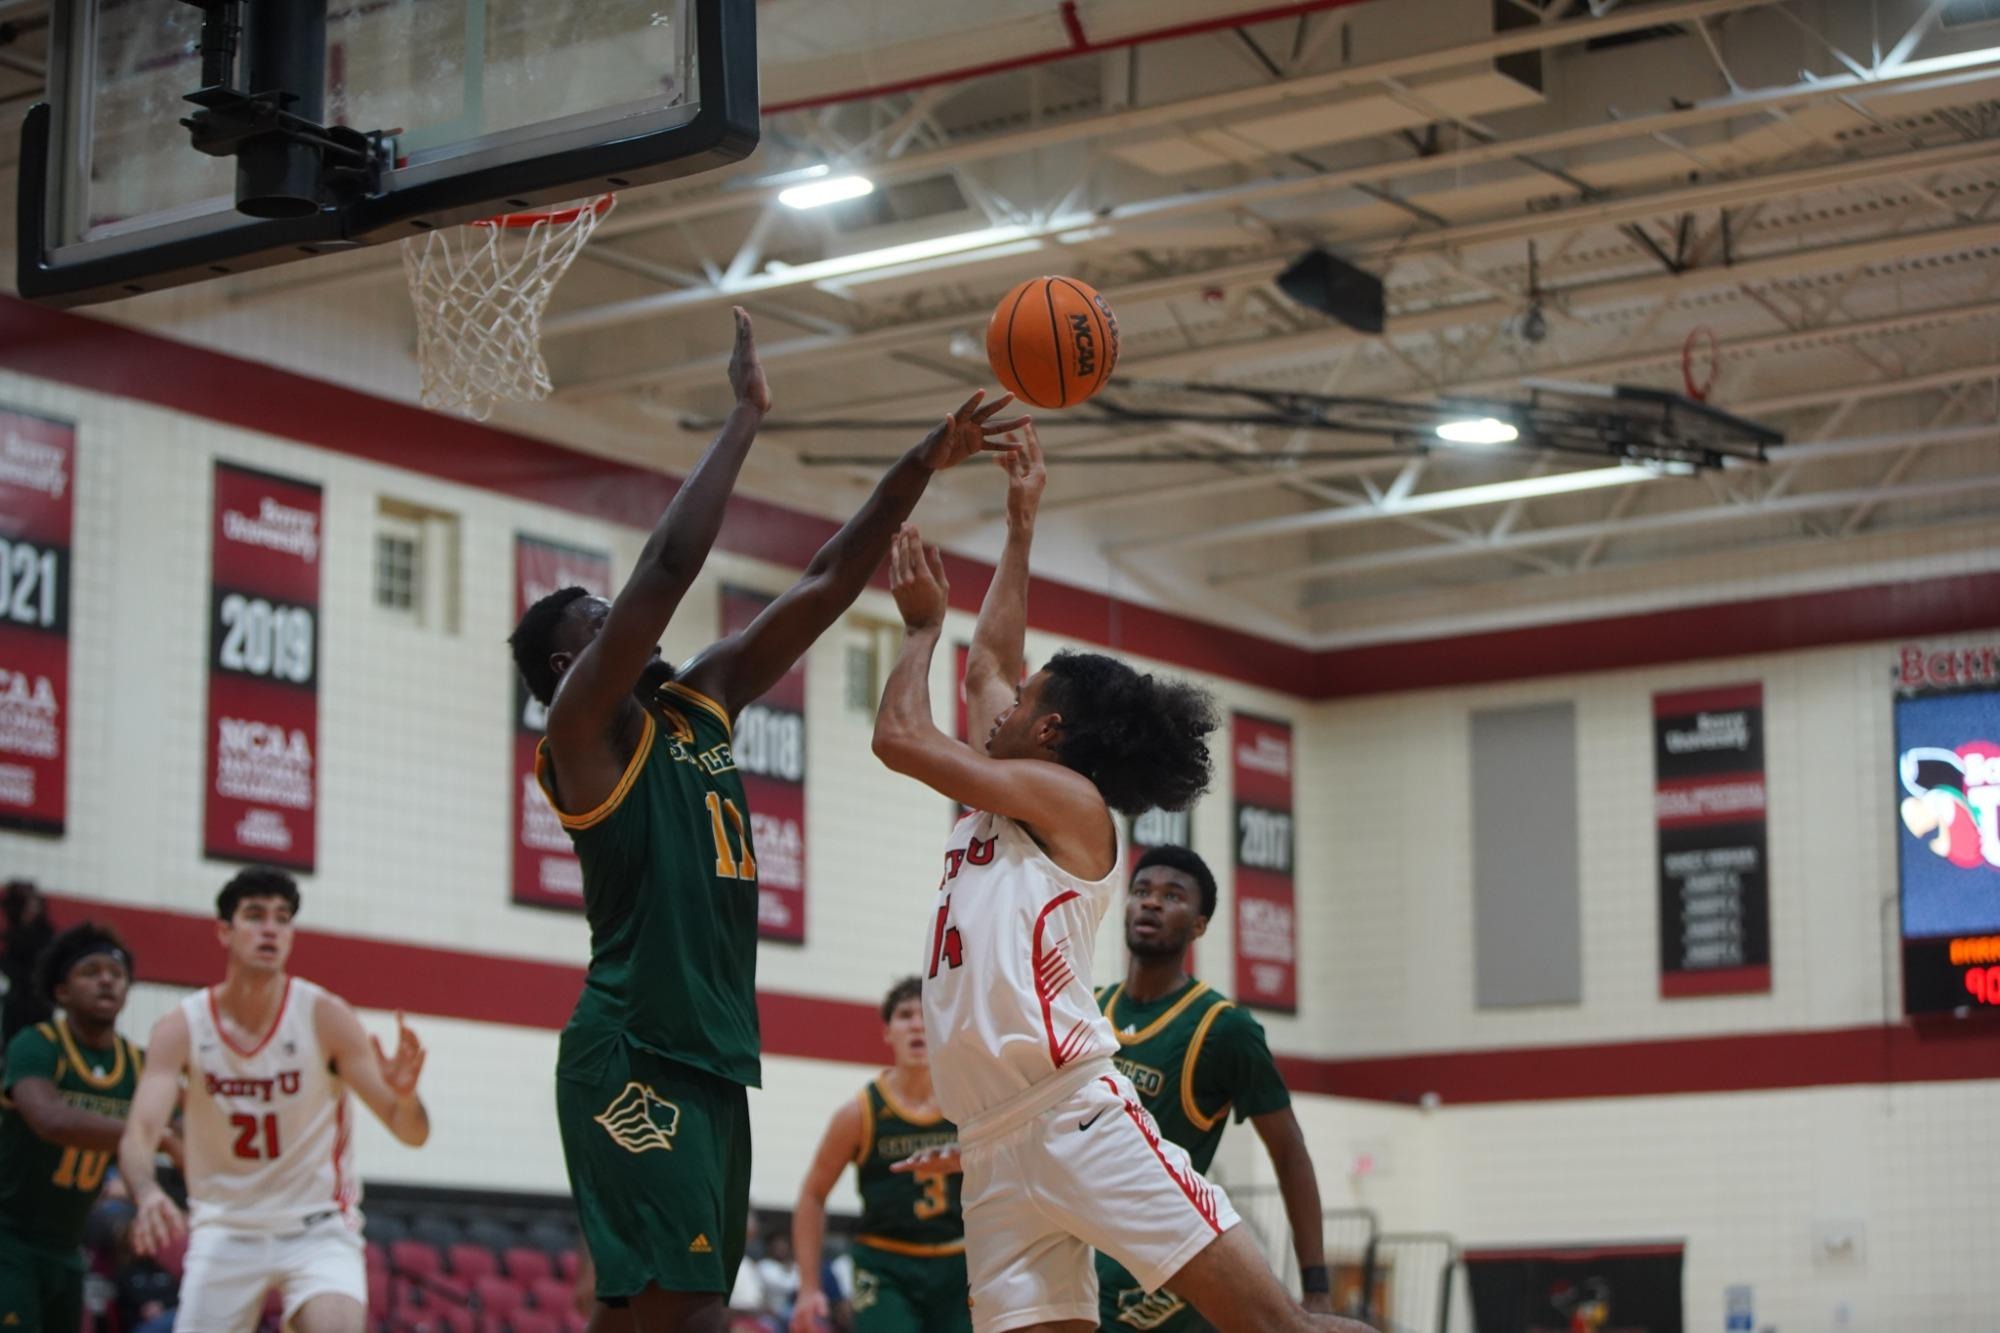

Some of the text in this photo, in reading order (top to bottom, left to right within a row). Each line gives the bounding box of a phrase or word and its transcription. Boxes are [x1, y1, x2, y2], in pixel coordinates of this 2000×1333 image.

[1069, 313, 1095, 377] NCAA
[220, 593, 314, 683] 2019
[218, 716, 311, 770] NCAA
[732, 704, 803, 782] 2018
[705, 791, 757, 882] 11
[966, 835, 999, 866] U
[1240, 806, 1291, 871] 2017
[204, 1071, 301, 1102] Barry U
[230, 1112, 281, 1160] 21
[53, 1145, 110, 1190] 10
[914, 1170, 946, 1218] 3
